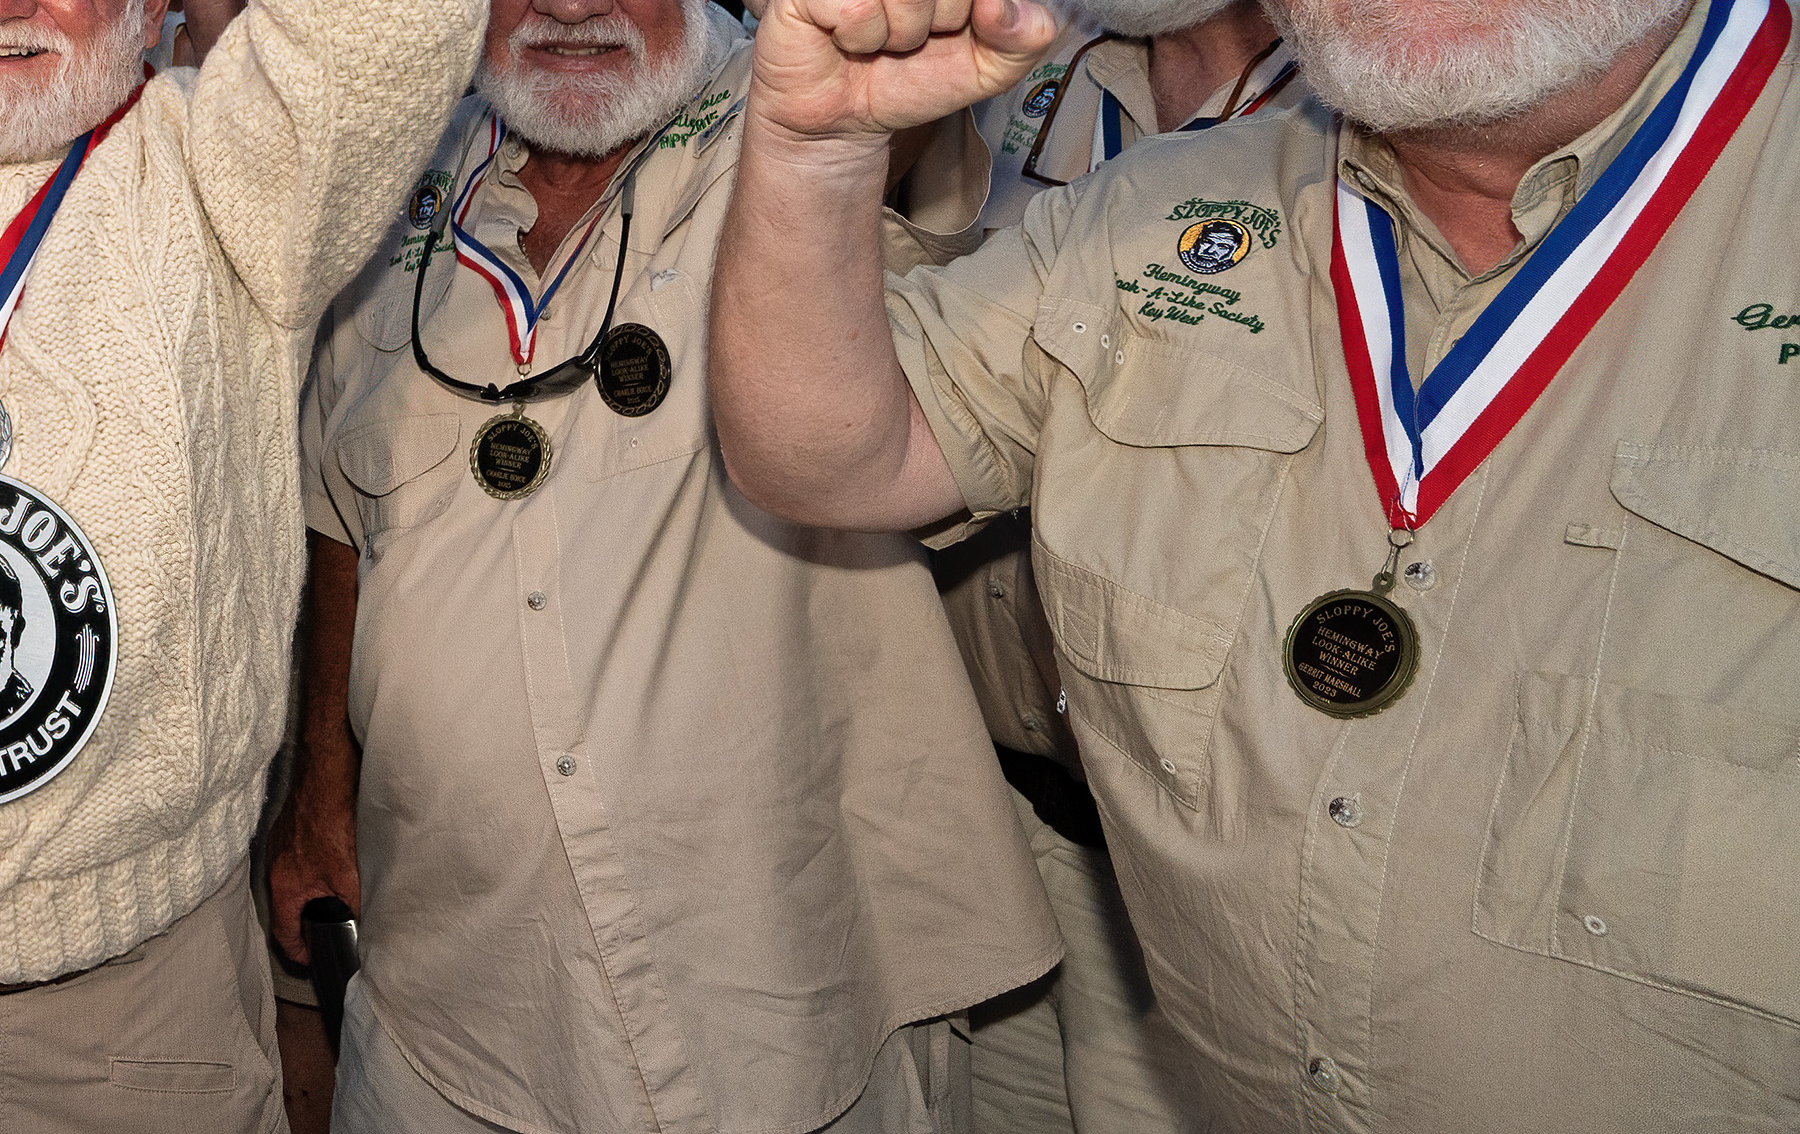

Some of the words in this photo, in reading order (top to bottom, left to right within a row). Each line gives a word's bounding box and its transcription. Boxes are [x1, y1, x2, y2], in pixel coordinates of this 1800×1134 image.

[1165, 203, 1247, 222] SLOPPY
[1241, 209, 1282, 250] JOE'S
[1142, 262, 1242, 306] Hemingway
[1114, 271, 1207, 311] ook-A-Like
[1207, 301, 1266, 335] Society
[1137, 300, 1164, 323] Key
[1163, 305, 1206, 327] West
[487, 423, 520, 442] SLOPPY
[490, 442, 533, 455] HEMINGWAY
[495, 457, 522, 470] WINNER
[1316, 604, 1374, 624] SLOPPY
[1372, 617, 1396, 653] JOE'S
[1317, 625, 1385, 661] HEMINGWAY
[1311, 635, 1377, 671] LOOK-ALIKE
[1319, 650, 1359, 676] WINNER
[1298, 661, 1325, 679] GERRIT
[1323, 673, 1362, 698] MARSHALL
[1312, 680, 1338, 698] 2023
